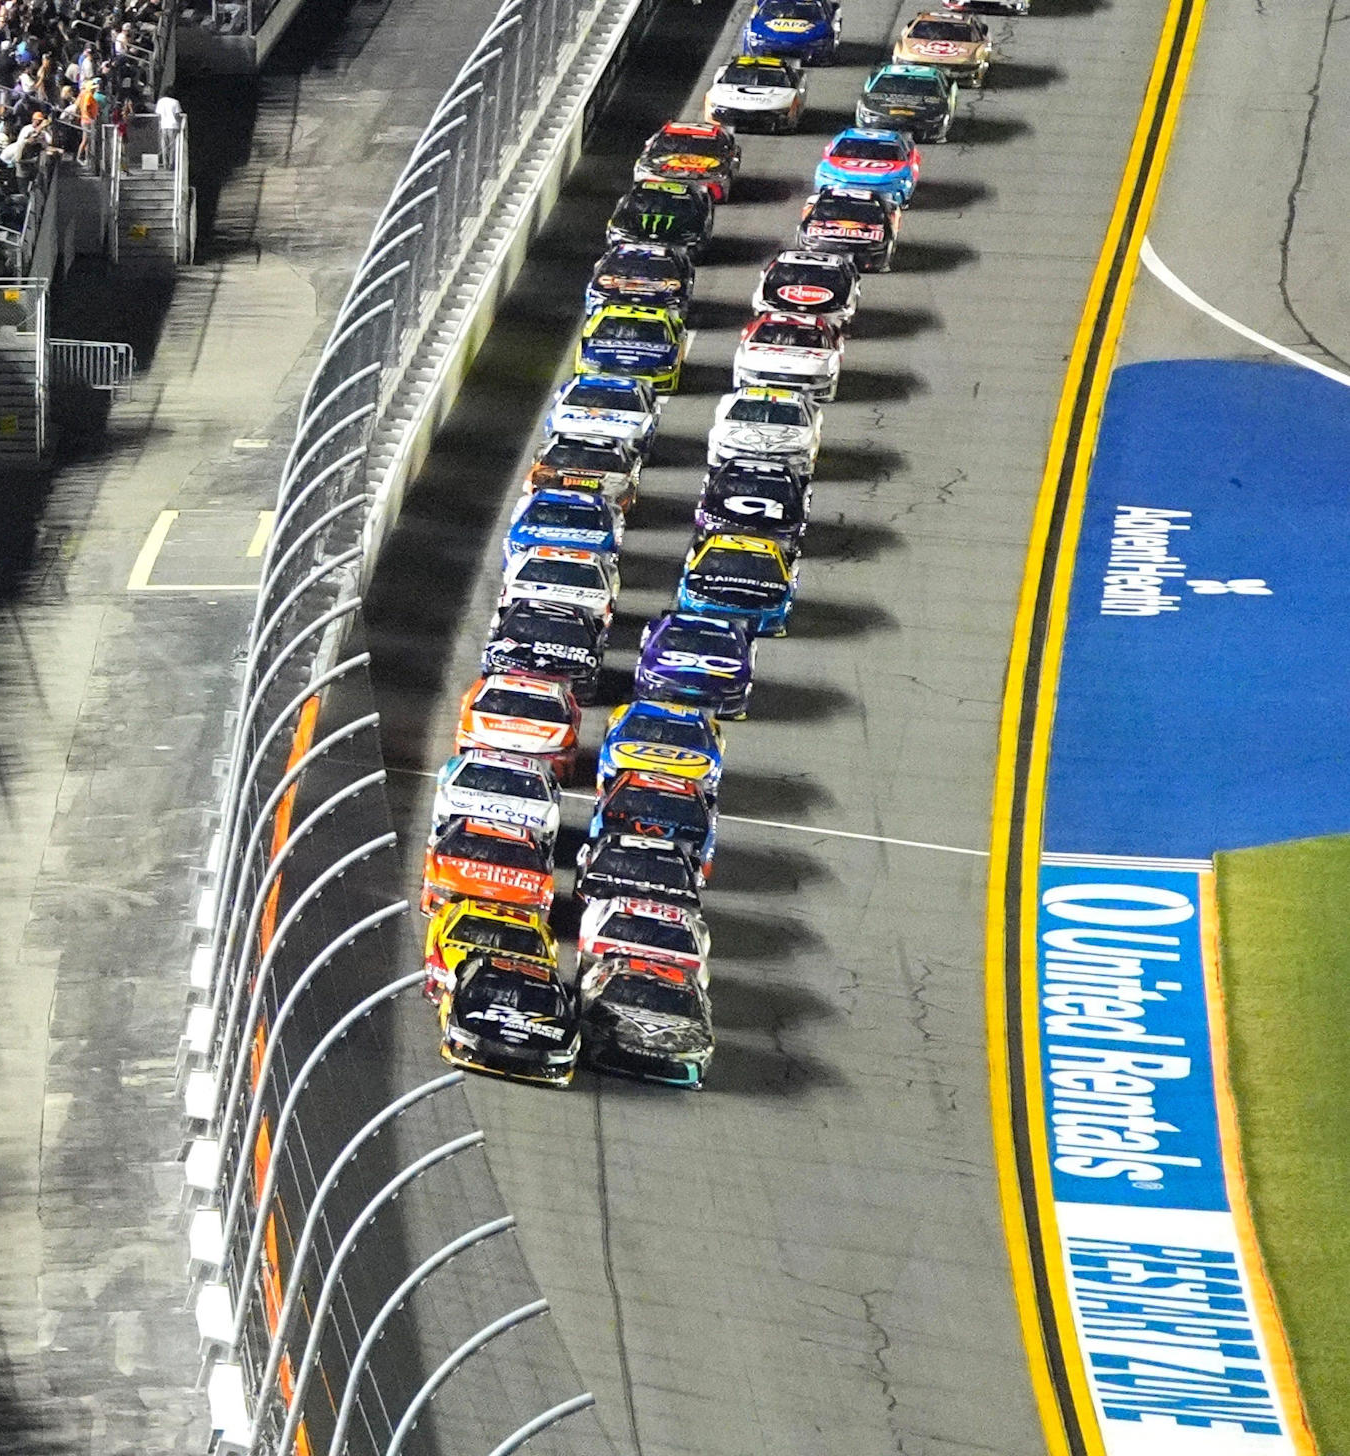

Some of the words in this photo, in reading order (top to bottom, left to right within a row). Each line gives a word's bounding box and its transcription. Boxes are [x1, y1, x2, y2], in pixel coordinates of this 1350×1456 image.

[773, 19, 810, 28] NAPA
[844, 159, 889, 169] STP
[807, 225, 847, 238] Red
[847, 226, 885, 243] Bull
[784, 284, 830, 301] Rheem
[1099, 504, 1193, 617] AdventHealth
[704, 574, 788, 592] GAINBRIDGE
[531, 646, 598, 668] CASINO
[480, 801, 549, 828] Kroger
[436, 854, 544, 883] Consumer
[460, 860, 545, 894] Cellular
[1042, 928, 1186, 1046] United
[465, 1007, 567, 1037] ADVANCE
[1048, 1045, 1202, 1180] Rentals
[1067, 1236, 1261, 1361] RESTART
[1088, 1351, 1283, 1436] ZONE
